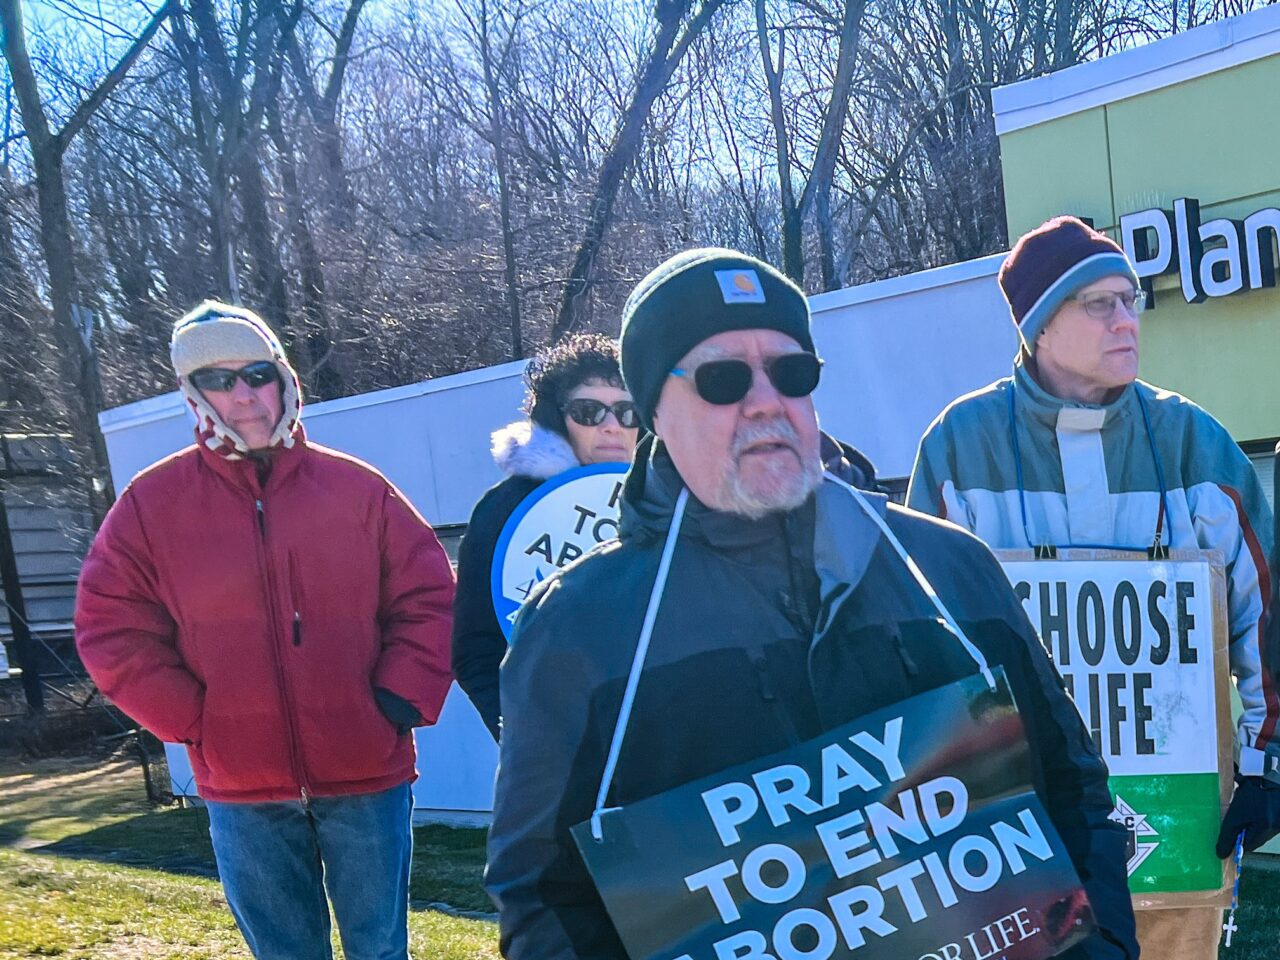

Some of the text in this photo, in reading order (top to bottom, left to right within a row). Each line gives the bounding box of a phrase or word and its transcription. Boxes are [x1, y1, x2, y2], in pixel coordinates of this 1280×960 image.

[1013, 580, 1199, 666] HOOSE
[1064, 673, 1156, 756] IFE
[701, 716, 907, 848] PRAY
[685, 776, 969, 924] TO END
